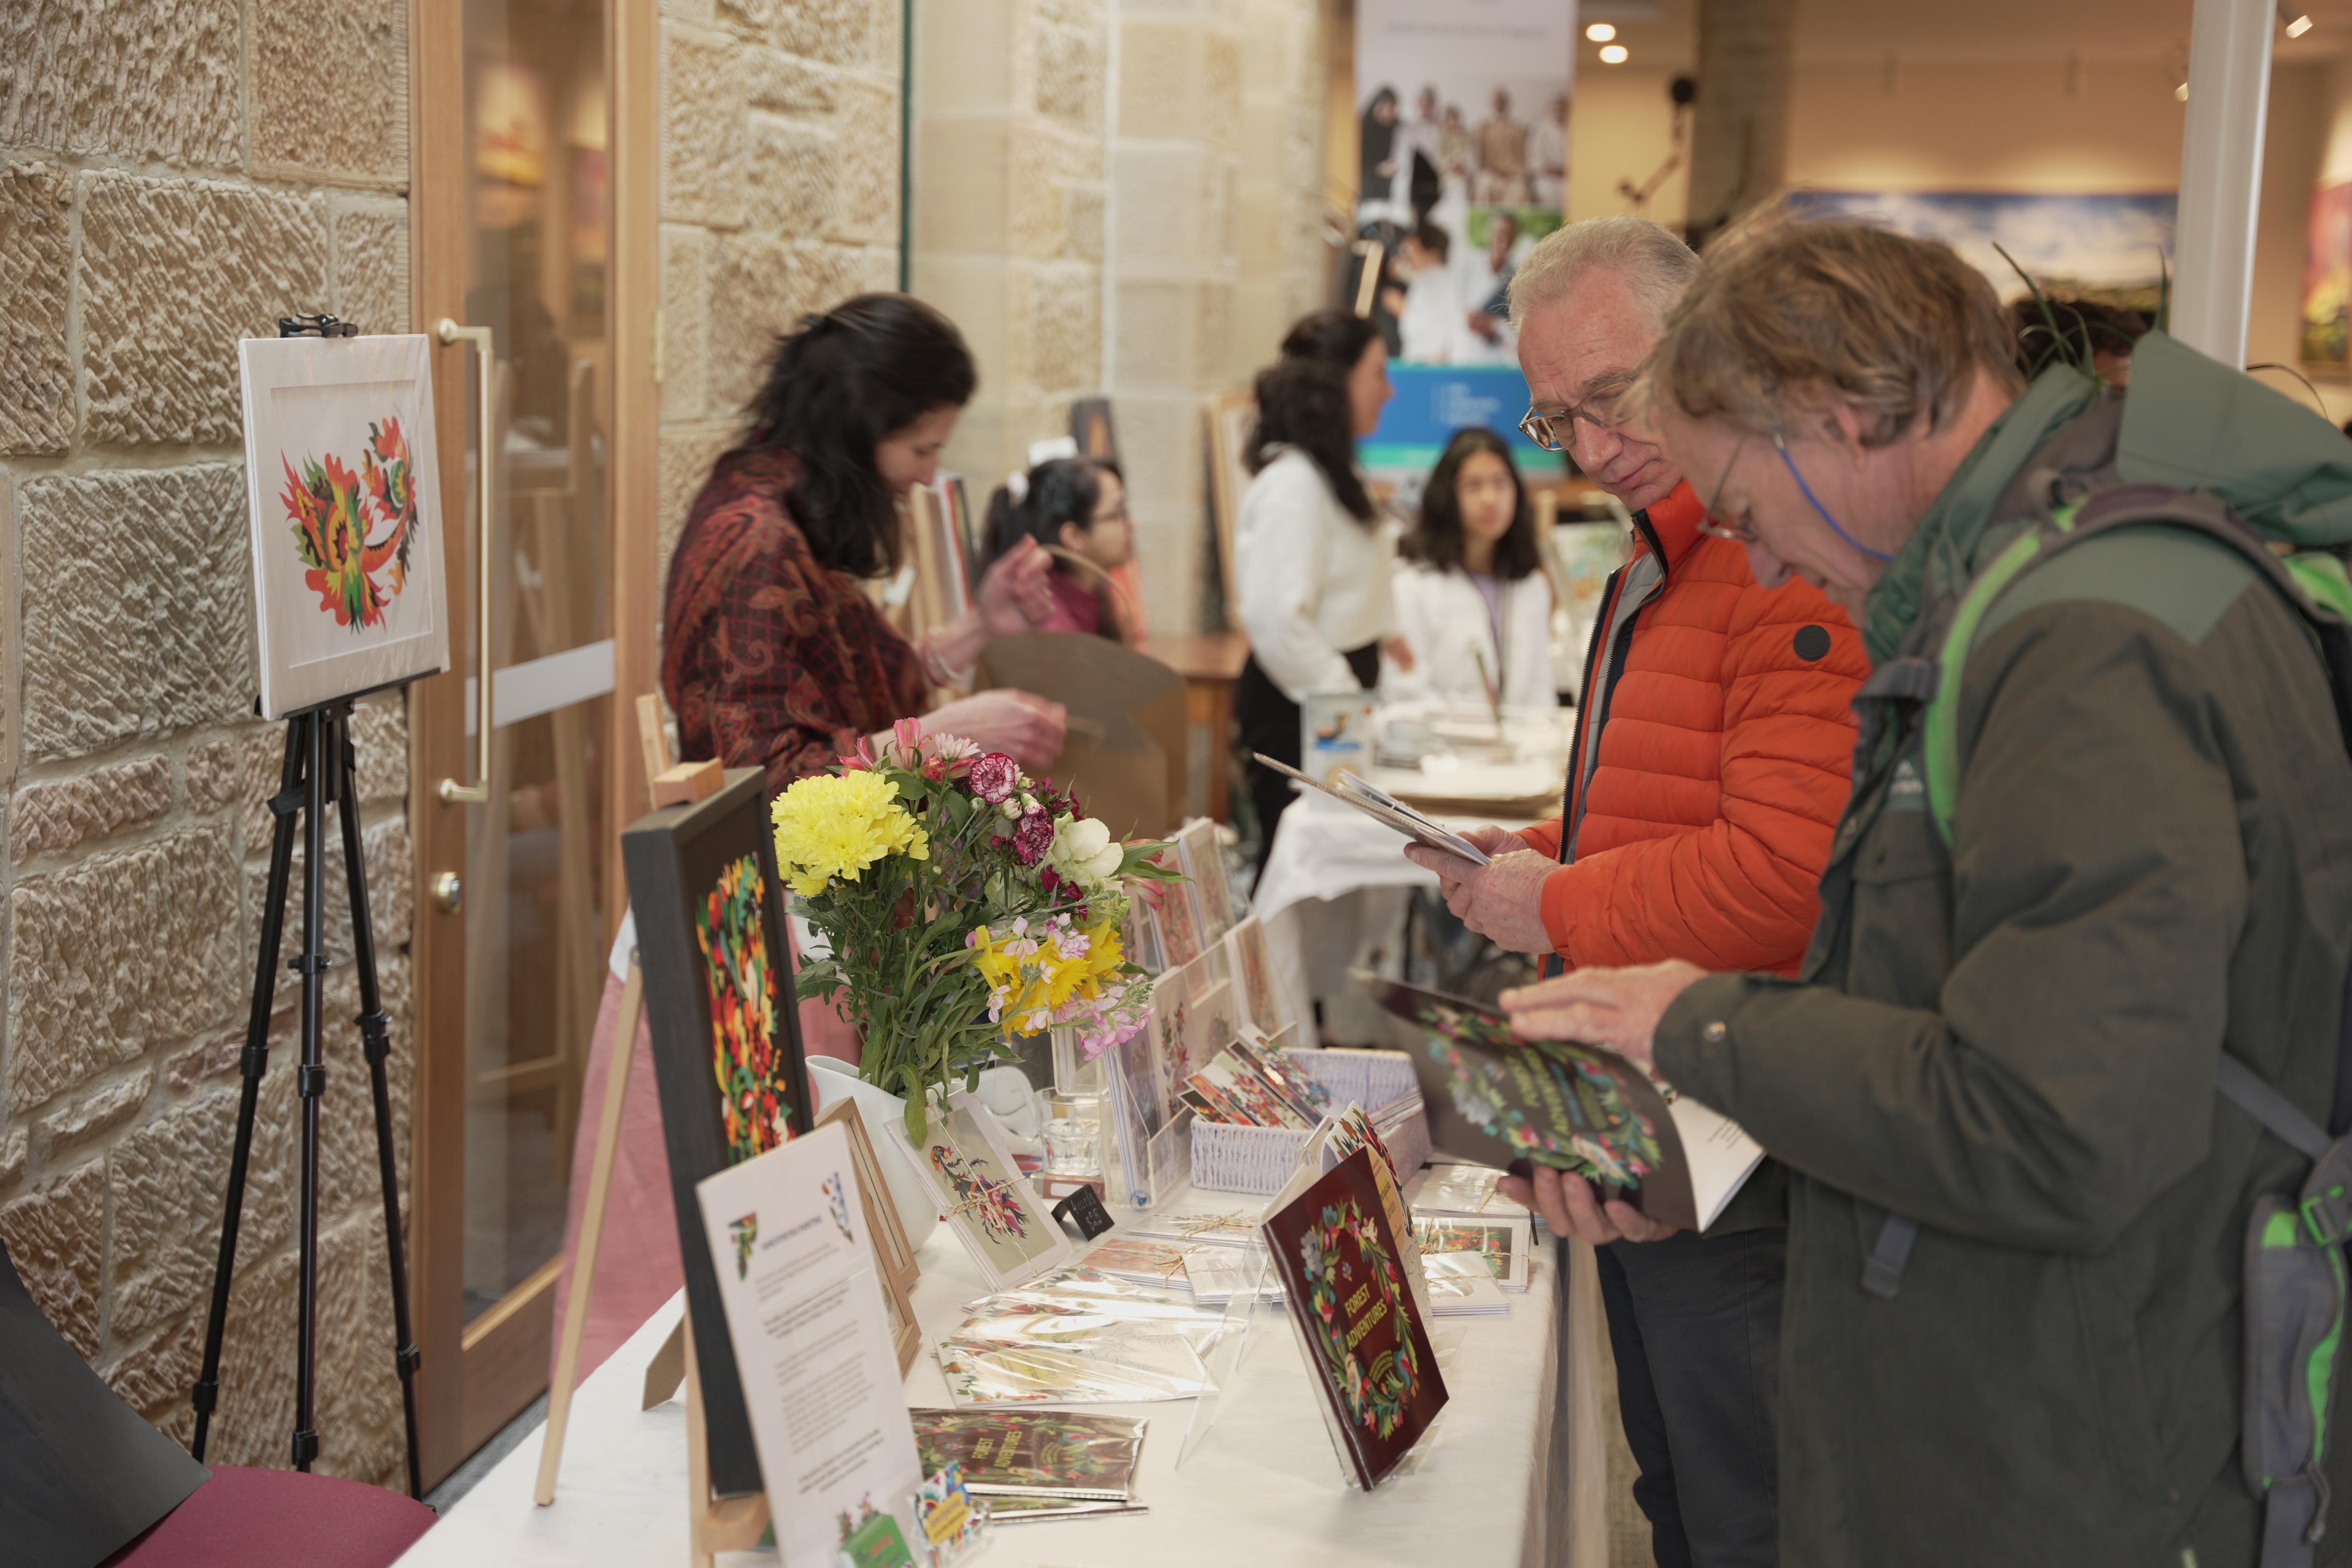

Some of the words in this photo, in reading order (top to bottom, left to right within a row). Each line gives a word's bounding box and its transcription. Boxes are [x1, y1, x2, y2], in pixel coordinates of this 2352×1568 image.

[1070, 1200, 1079, 1215] 4
[1077, 1190, 1096, 1211] cards
[1086, 1208, 1103, 1232] $25
[1344, 1282, 1370, 1318] FOREST
[1345, 1297, 1387, 1351] ADVENTURES
[971, 1437, 995, 1459] FOREST
[993, 1431, 1023, 1468] ADVENTURES
